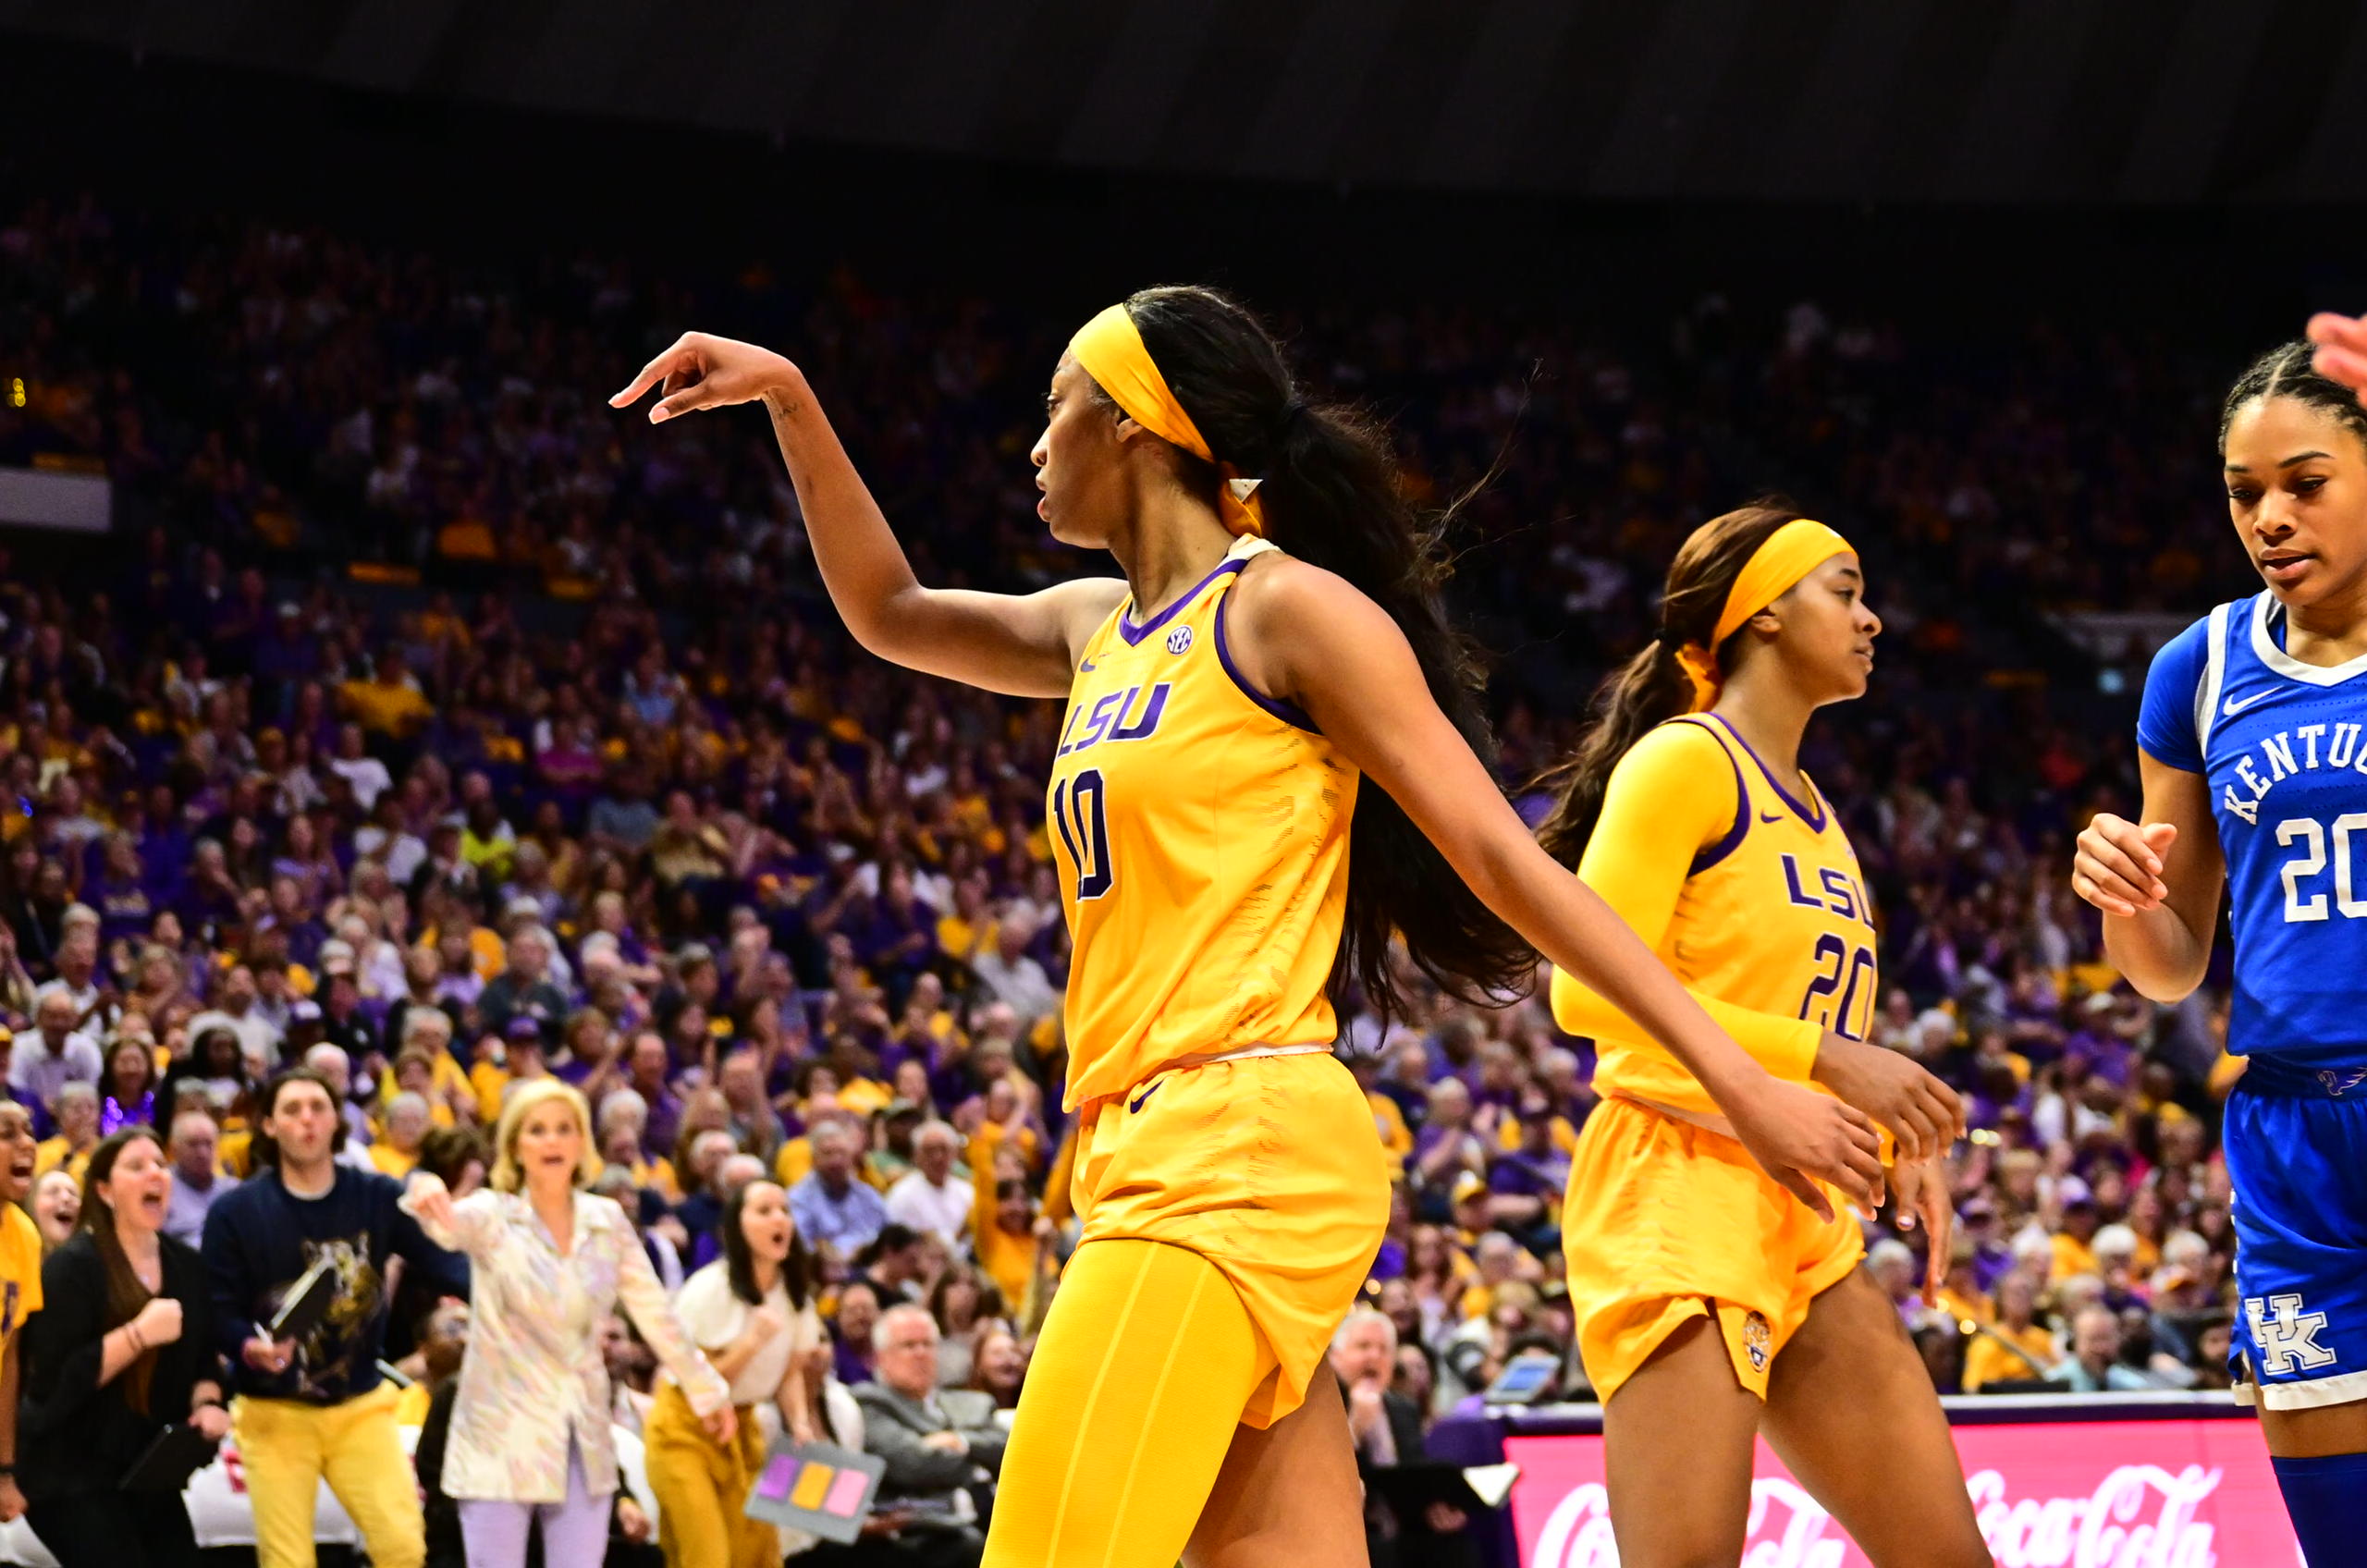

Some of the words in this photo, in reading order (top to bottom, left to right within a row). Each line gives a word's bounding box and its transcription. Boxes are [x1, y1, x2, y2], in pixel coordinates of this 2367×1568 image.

[1167, 627, 1192, 655] SEC
[1056, 682, 1171, 759] LSU
[2224, 722, 2367, 826] KENTU
[1053, 768, 1114, 902] 10
[2275, 813, 2367, 923] 20
[1798, 933, 1875, 1042] 20
[2244, 1292, 2337, 1376] UK
